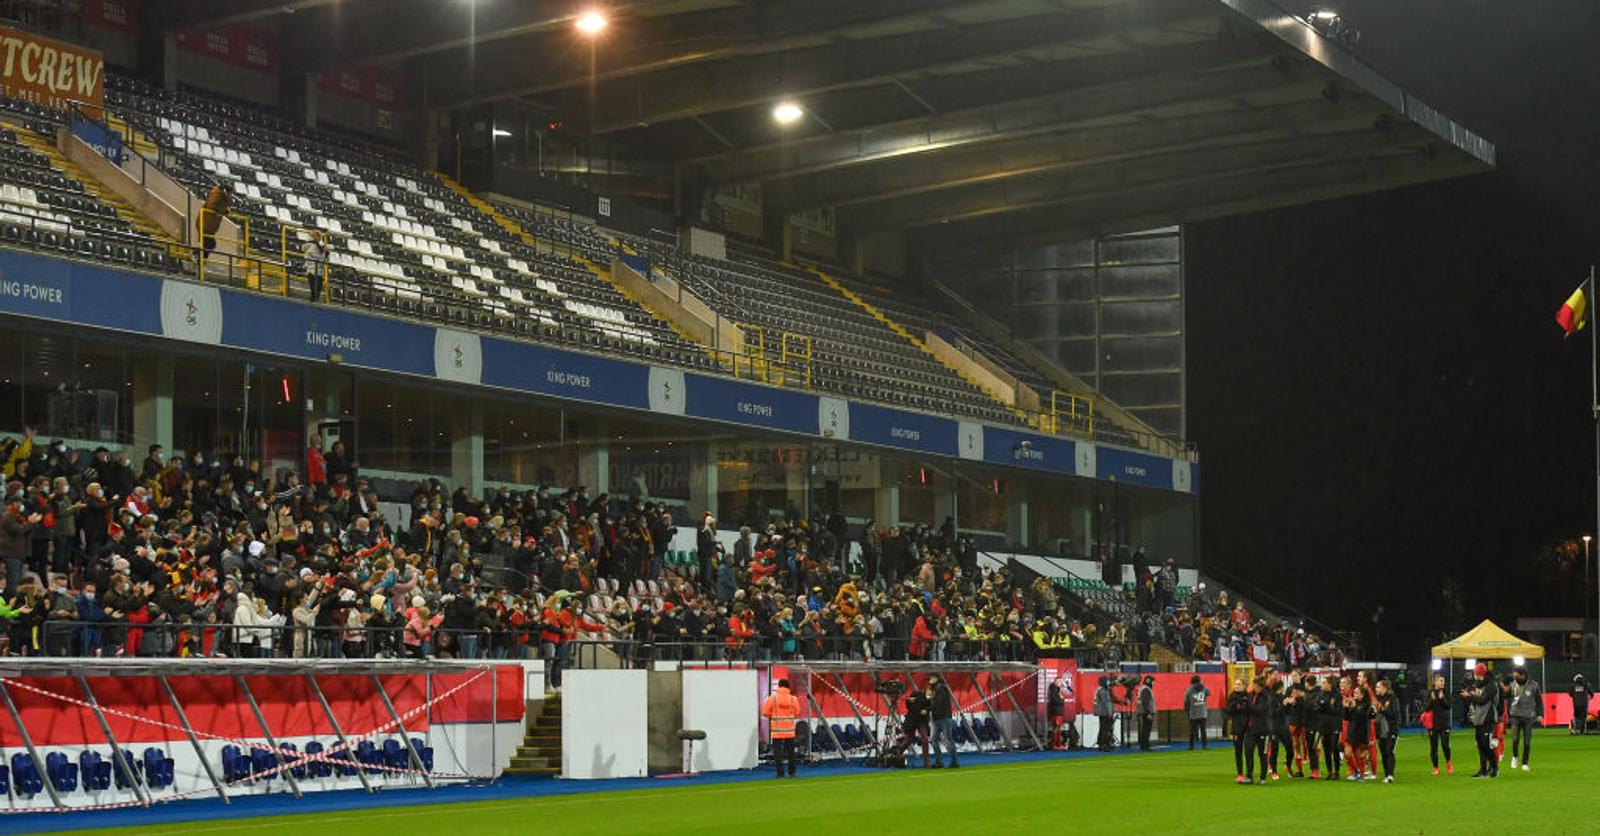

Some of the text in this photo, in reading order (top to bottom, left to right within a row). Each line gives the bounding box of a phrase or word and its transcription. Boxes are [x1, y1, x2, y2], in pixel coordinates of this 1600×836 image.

[0, 36, 104, 97] TCREW
[23, 283, 63, 304] POWER
[306, 331, 361, 351] KING POWER
